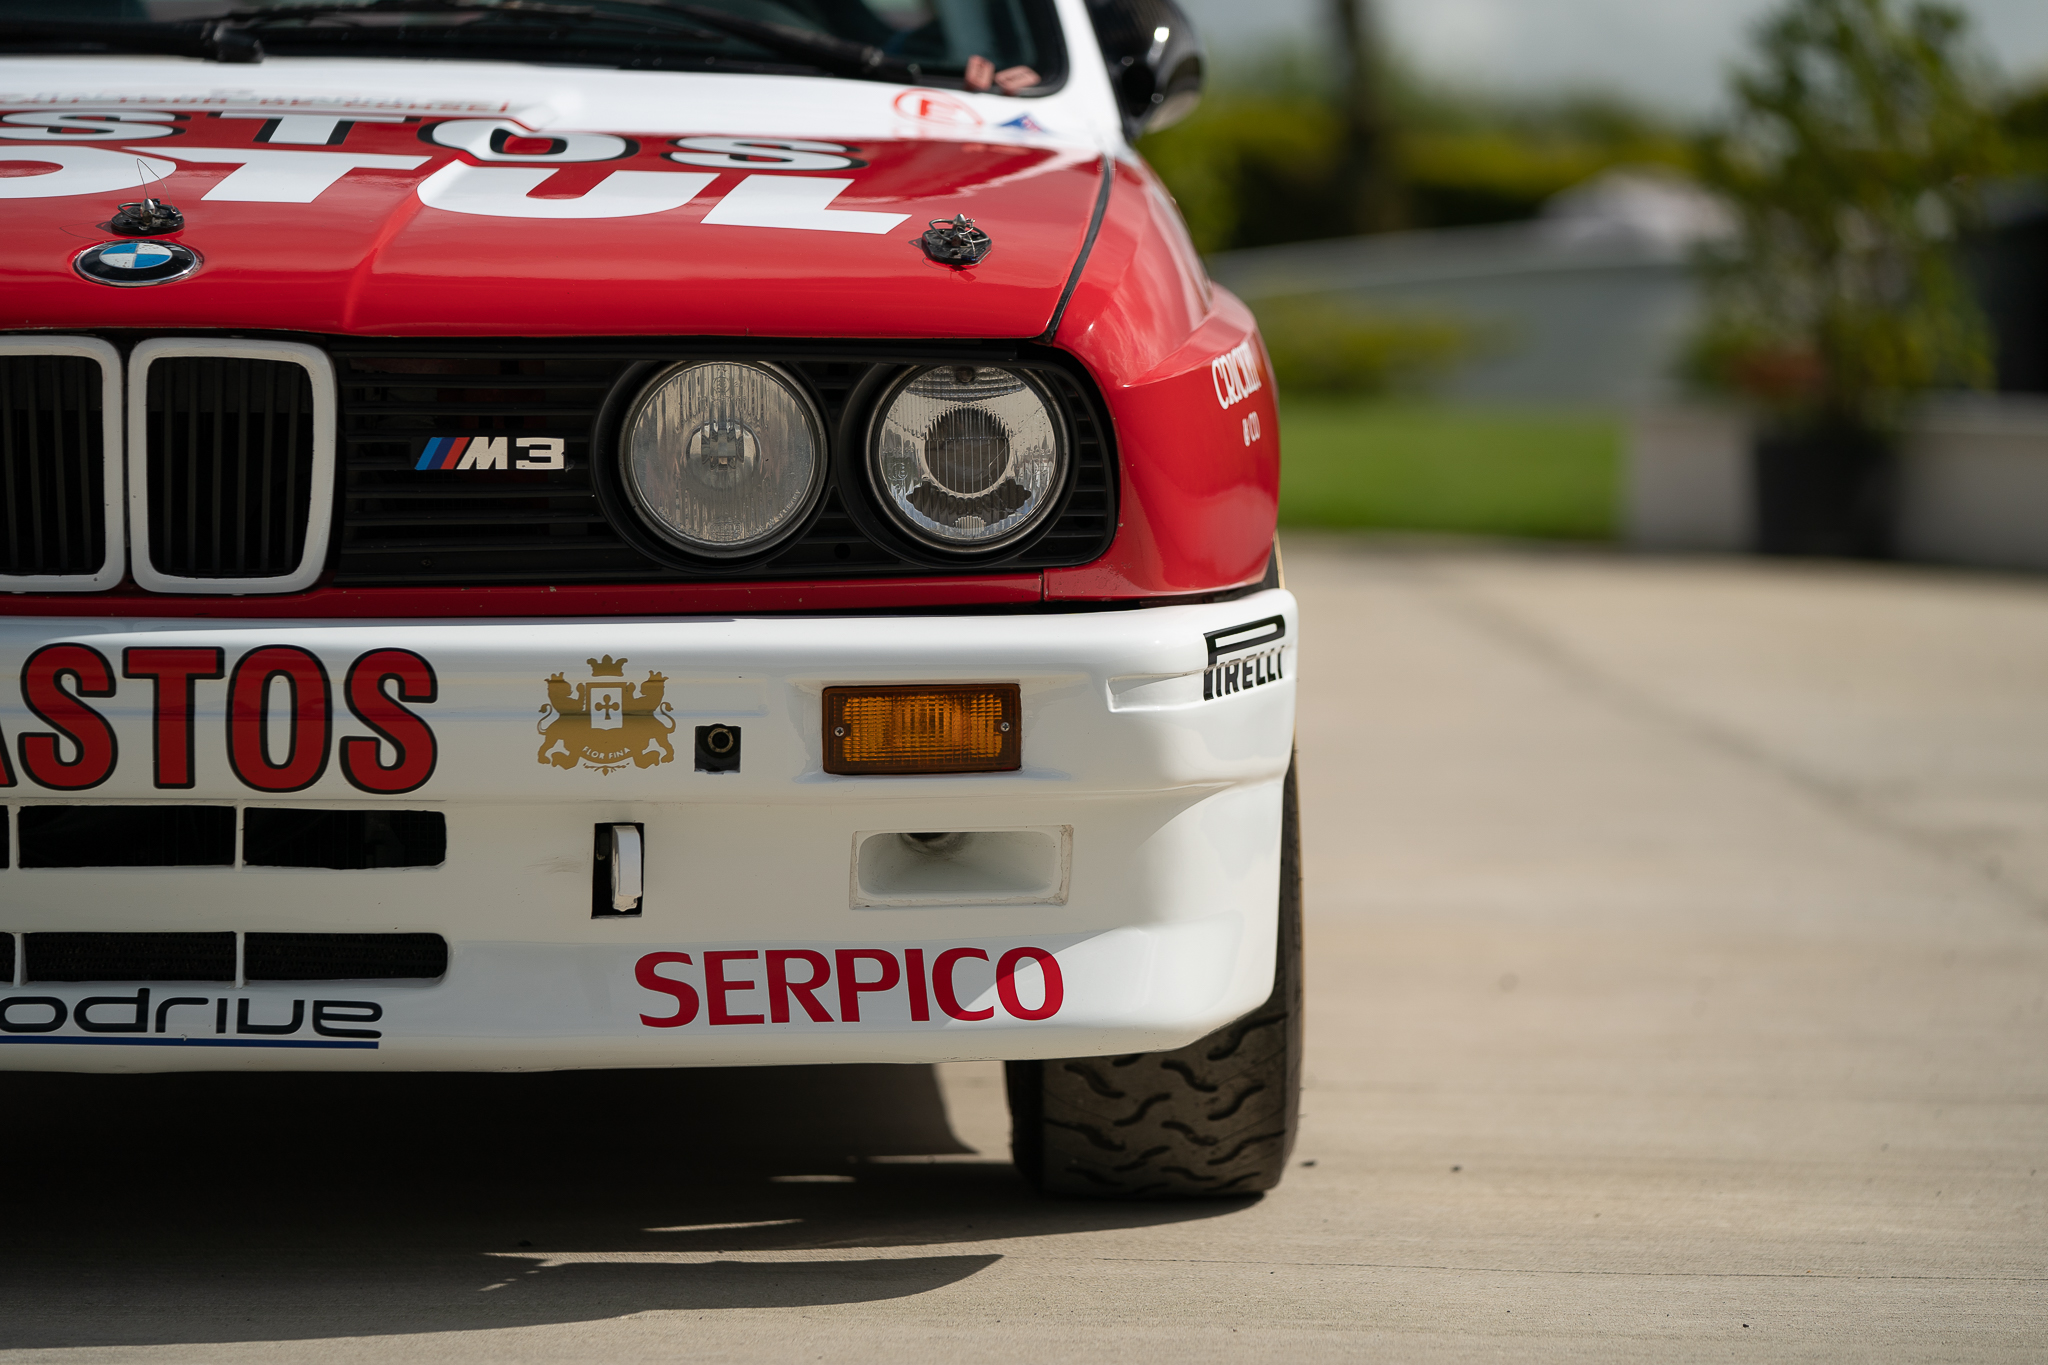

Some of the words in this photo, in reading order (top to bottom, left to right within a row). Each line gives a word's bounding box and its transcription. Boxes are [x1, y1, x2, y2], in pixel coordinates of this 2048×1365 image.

[456, 436, 565, 470] M3
[1203, 614, 1286, 701] PIRELLI
[0, 642, 438, 795] STOS
[582, 746, 605, 760] FLOR
[608, 747, 631, 760] FINA
[634, 946, 1064, 1028] SERPICO
